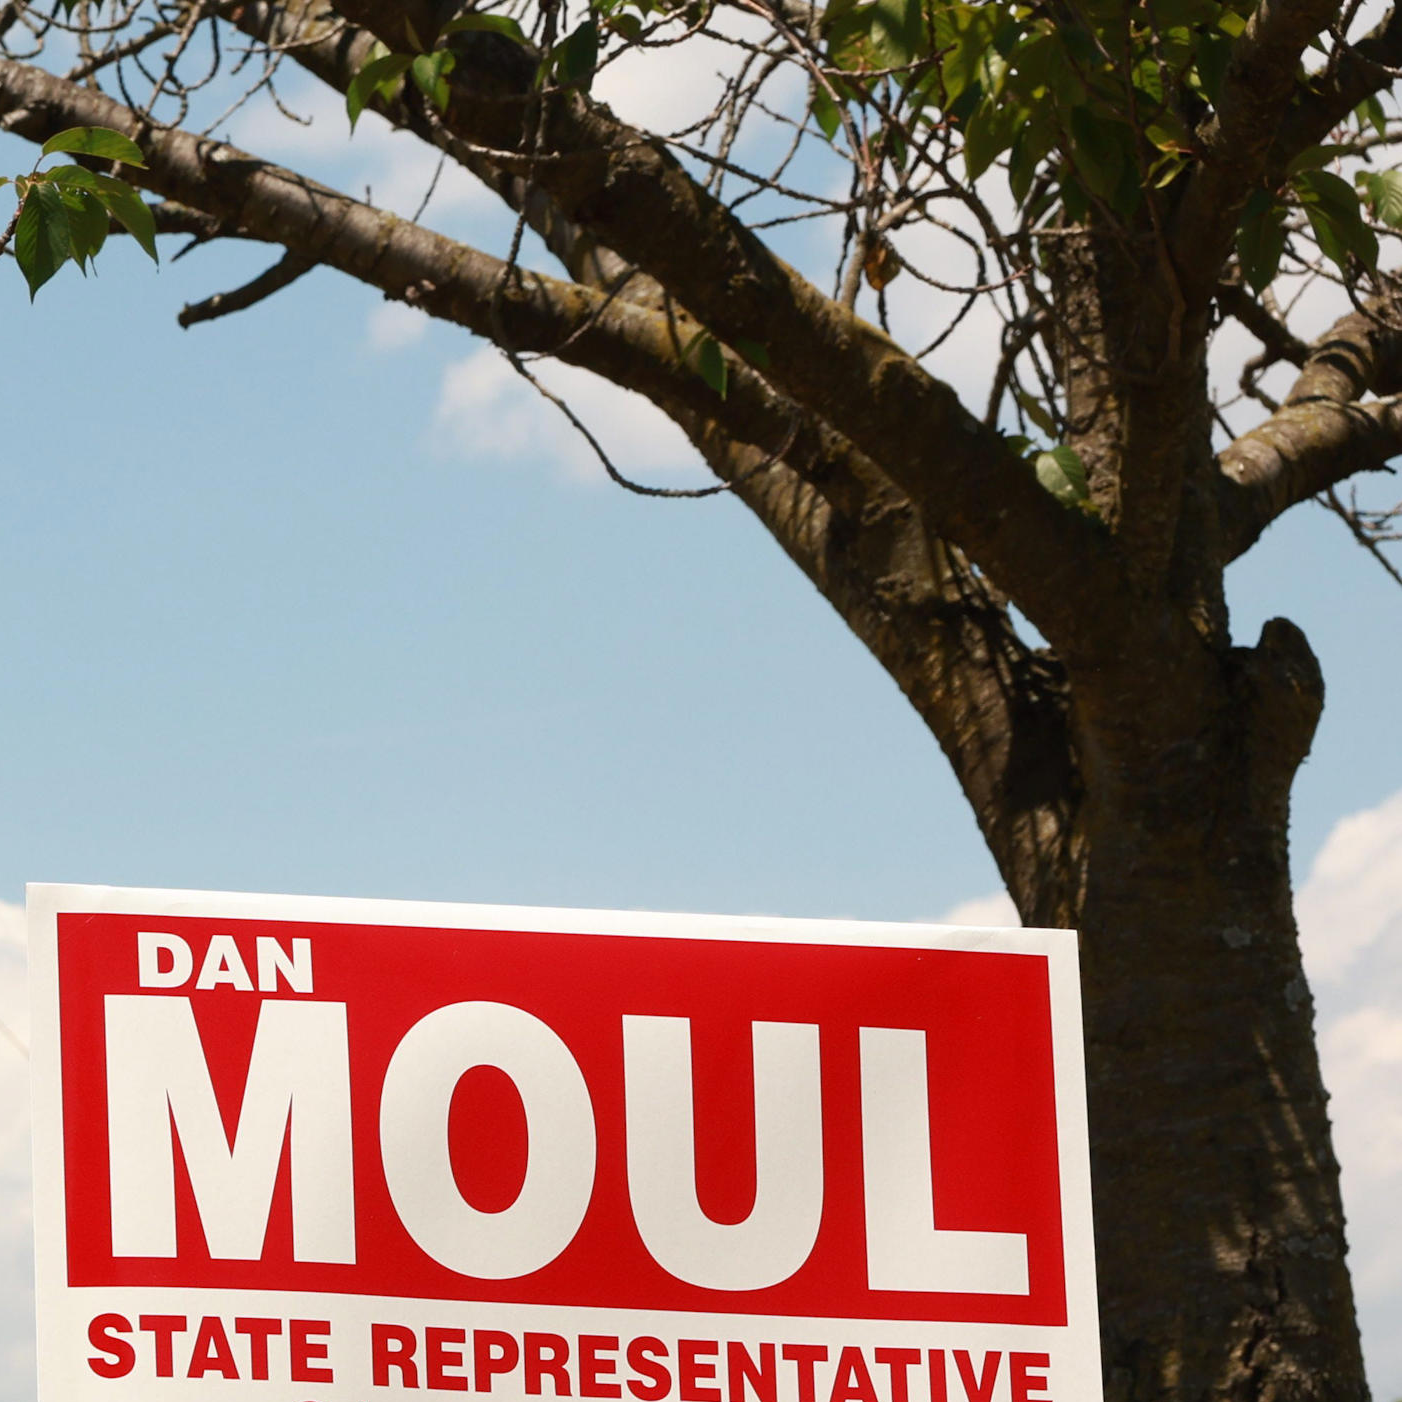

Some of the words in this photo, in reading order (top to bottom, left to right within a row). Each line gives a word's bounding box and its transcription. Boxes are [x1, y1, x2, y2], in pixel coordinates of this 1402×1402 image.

[138, 932, 313, 993] DAN
[103, 995, 1029, 1297] MOUL
[88, 1313, 333, 1383] STATE
